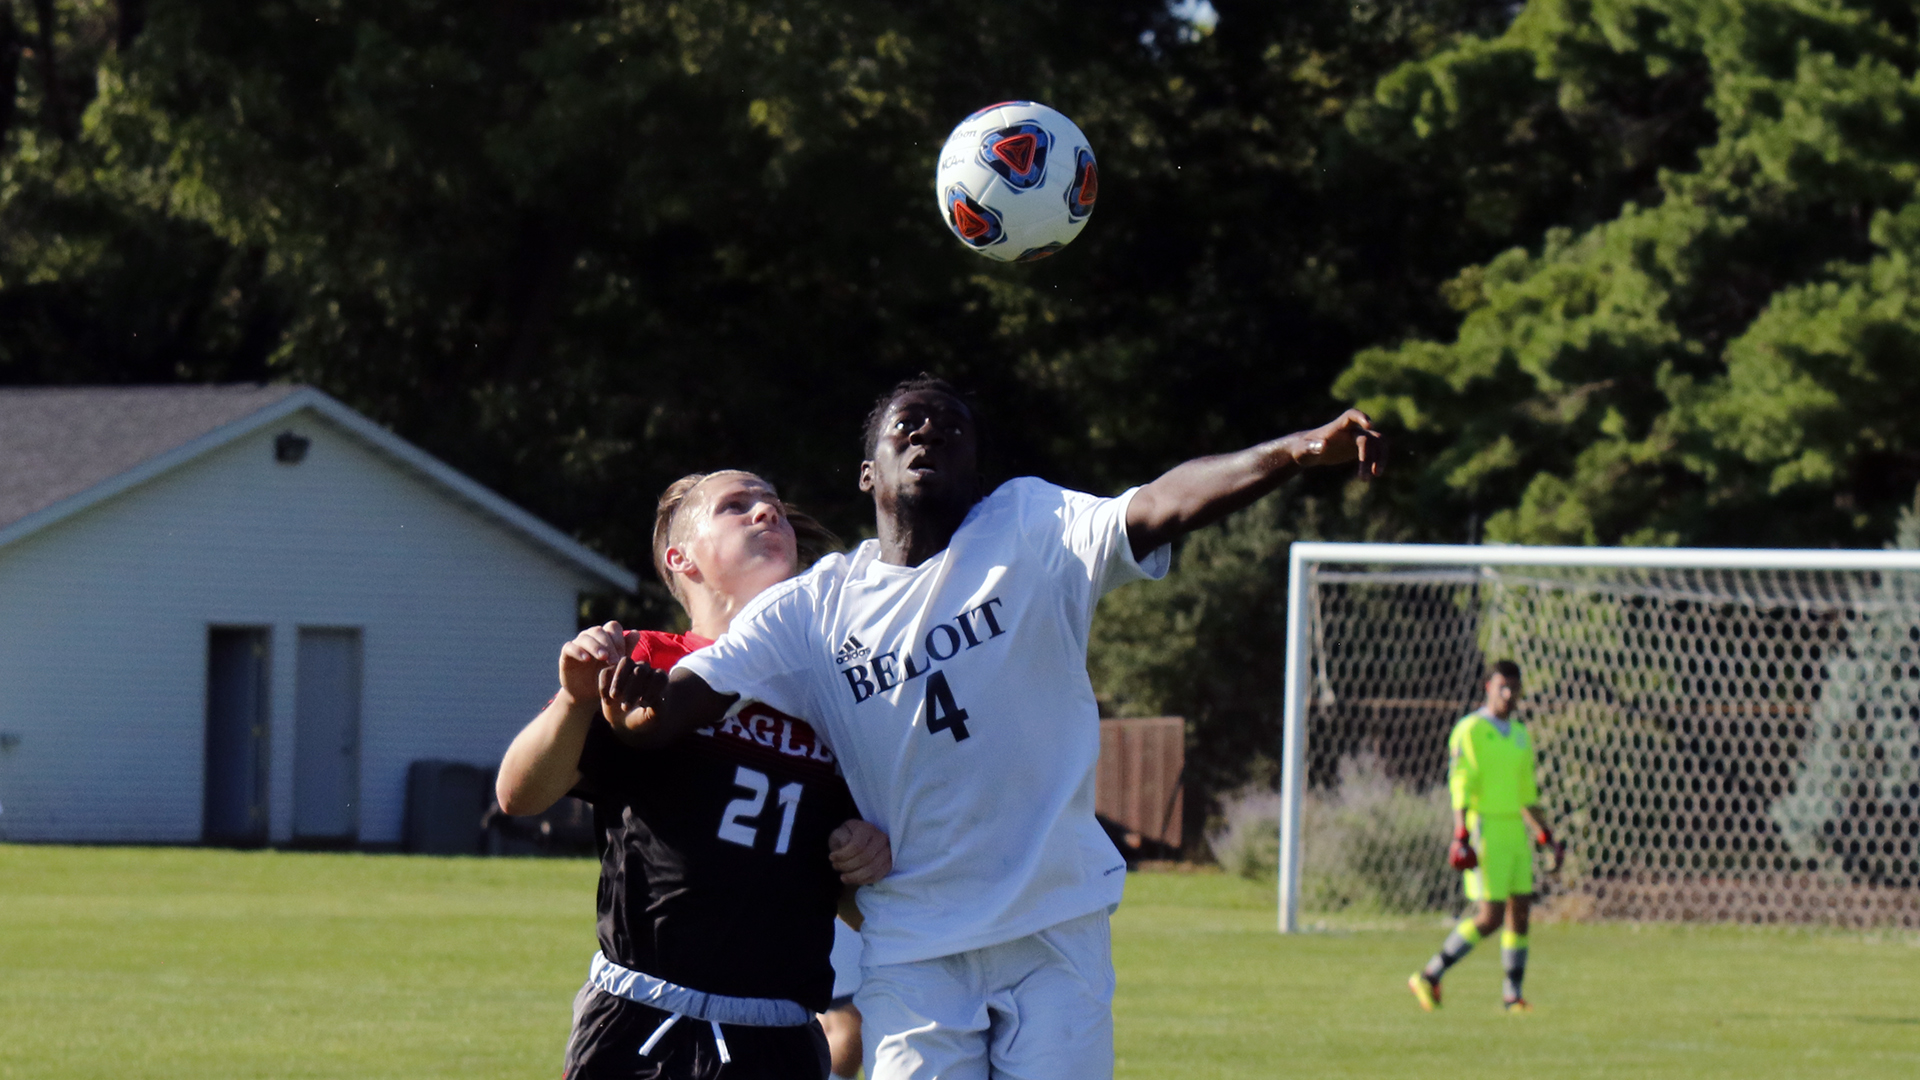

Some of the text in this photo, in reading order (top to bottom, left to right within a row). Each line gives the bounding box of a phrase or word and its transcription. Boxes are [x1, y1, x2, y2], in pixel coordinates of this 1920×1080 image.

[836, 647, 871, 665] adidas
[841, 597, 1006, 704] BELOIT
[926, 670, 970, 742] 4
[717, 765, 804, 855] 21
